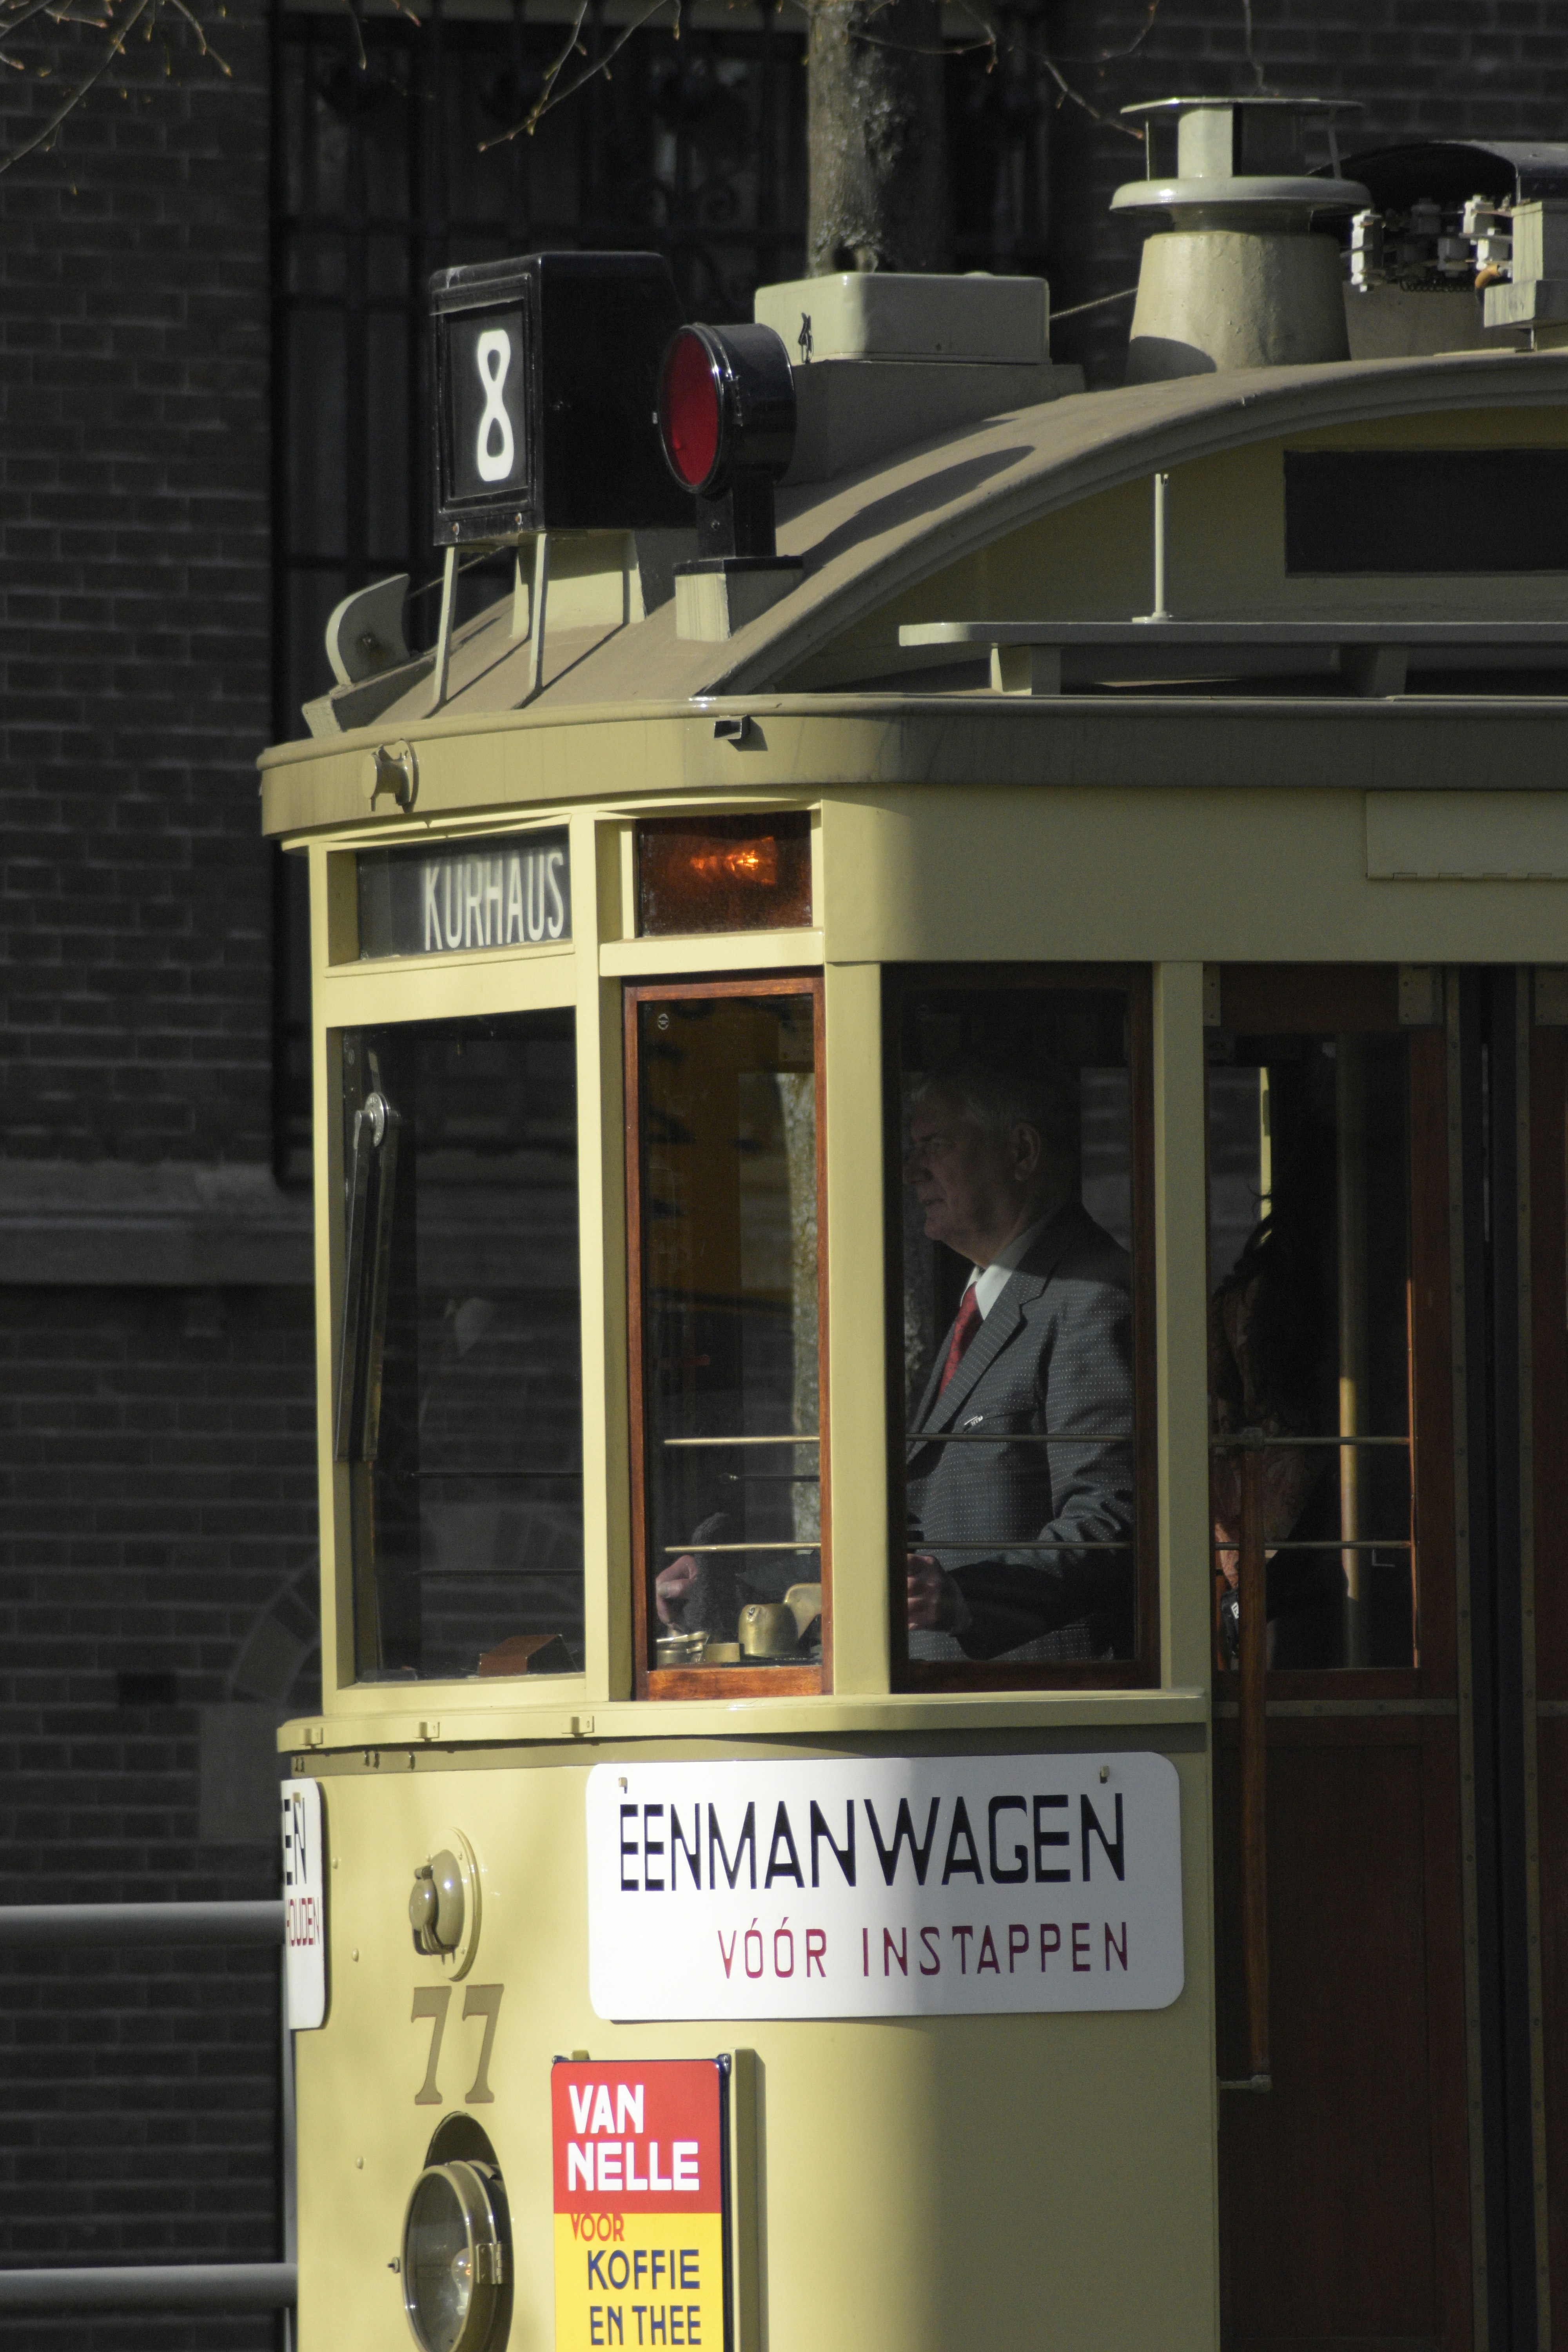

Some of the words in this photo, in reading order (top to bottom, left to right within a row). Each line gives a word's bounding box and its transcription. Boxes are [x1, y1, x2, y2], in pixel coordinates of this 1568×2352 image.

[477, 329, 514, 481] 8
[425, 851, 564, 951] KURHAUS
[620, 1793, 1125, 1892] EENMANWAGEN
[718, 1917, 826, 1978] VÓÓR
[863, 1921, 1128, 1976] INSTAPPEN
[411, 1984, 504, 2105] 77
[568, 2084, 644, 2134] VAN
[568, 2141, 700, 2192] NELLE
[571, 2213, 624, 2241] VOOR
[588, 2249, 700, 2290] KOFFIE
[590, 2306, 624, 2345] EN
[632, 2305, 702, 2345] THEE
